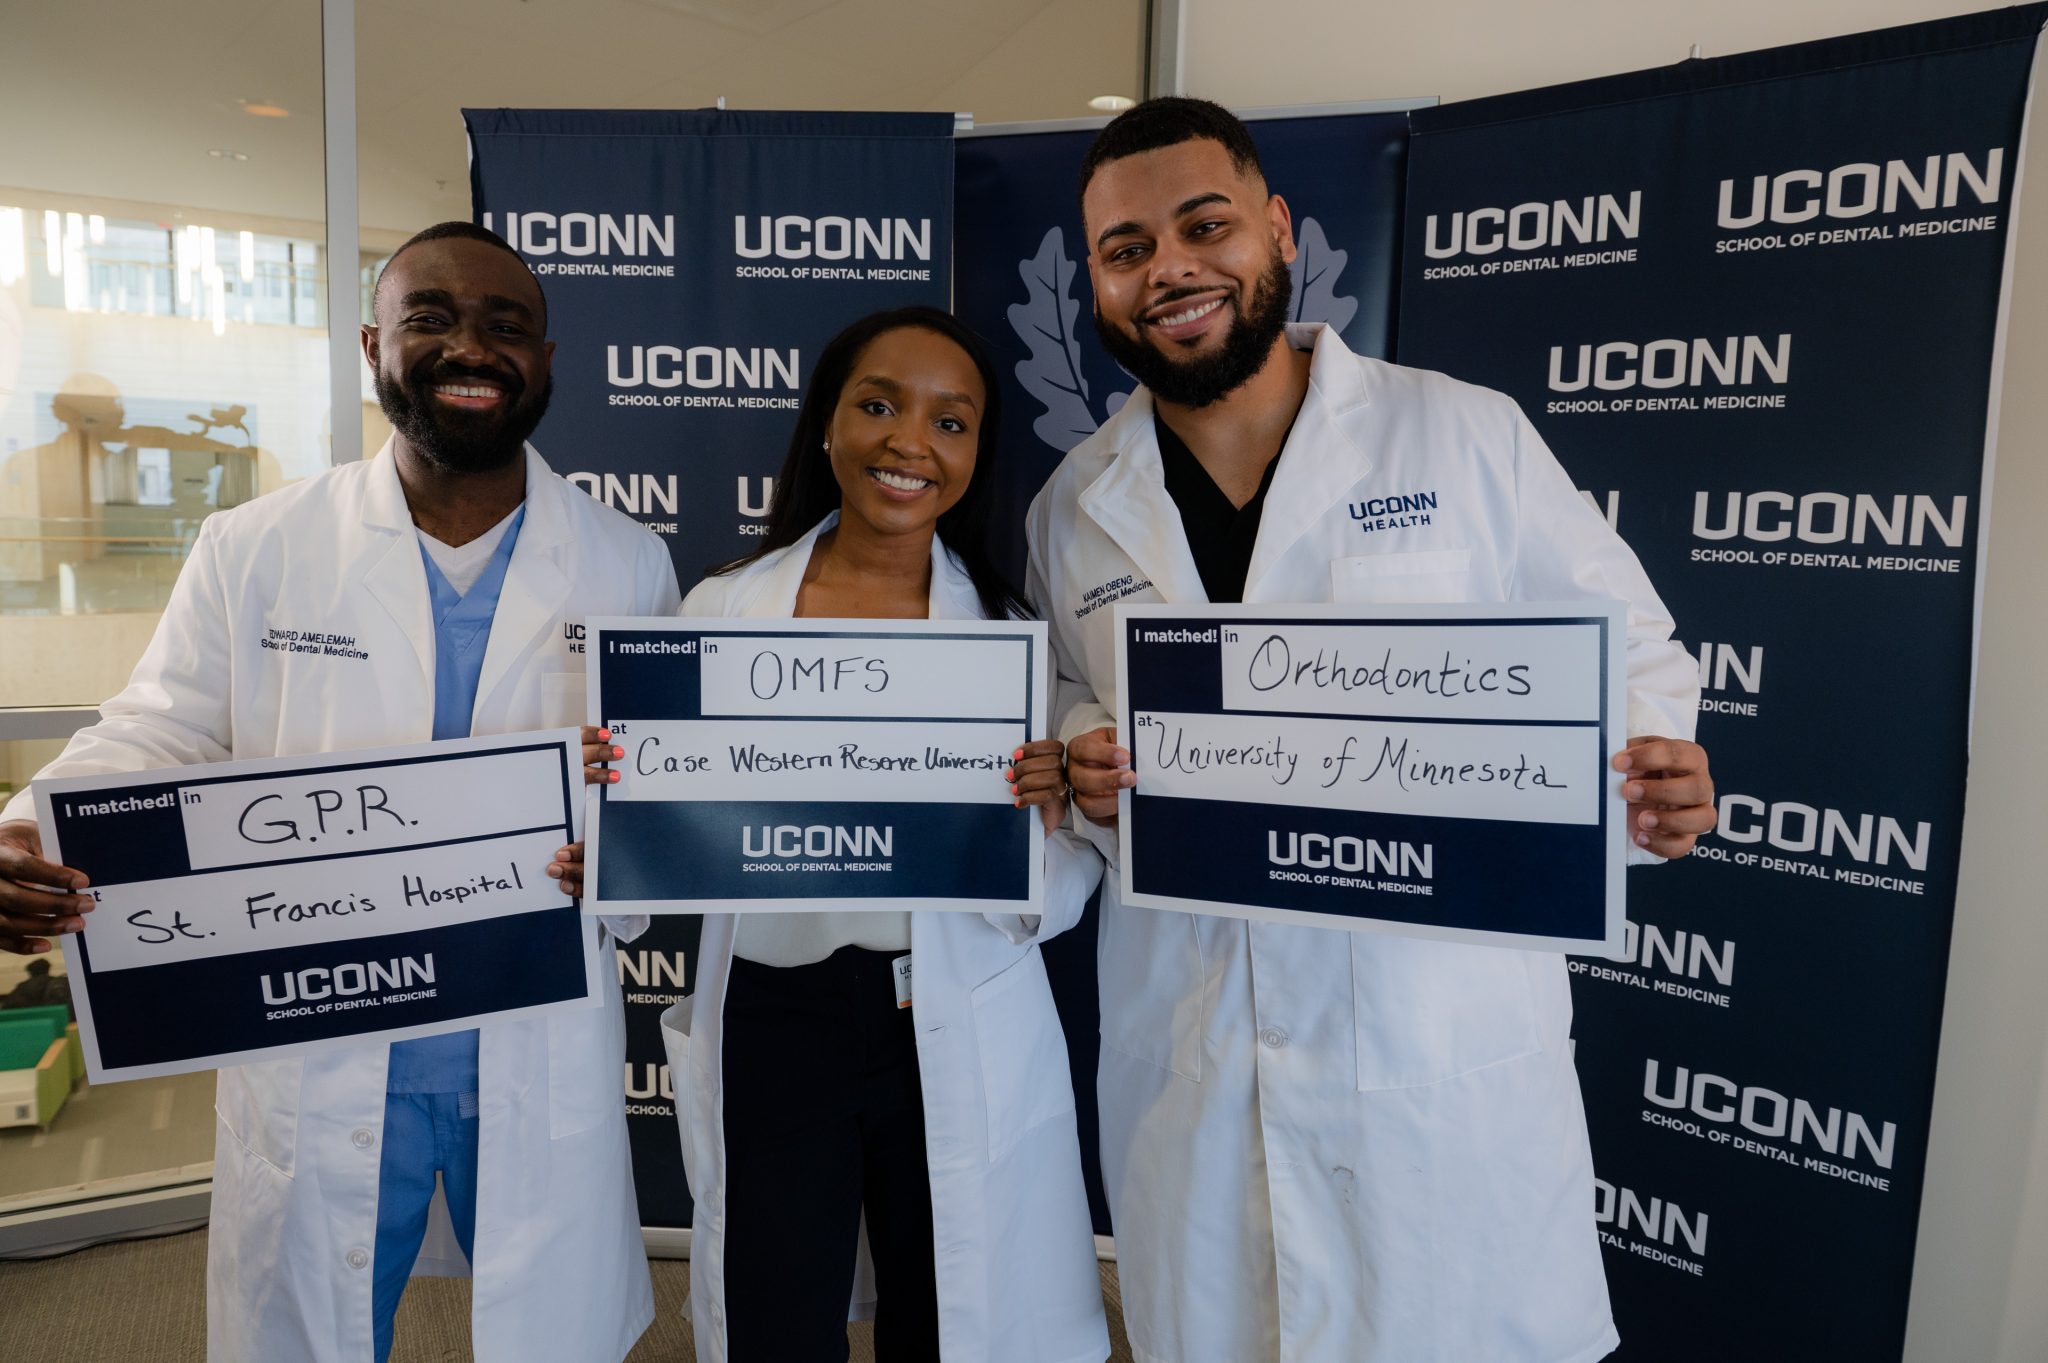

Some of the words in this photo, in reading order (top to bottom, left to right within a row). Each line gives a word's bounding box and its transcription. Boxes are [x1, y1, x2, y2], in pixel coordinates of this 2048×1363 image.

[1717, 148, 2004, 229] UCONN
[483, 212, 674, 257] UCONN
[735, 215, 931, 261] UCONN
[1425, 190, 1642, 259] UCONN
[1715, 236, 1786, 253] SCHOOL
[1790, 232, 1816, 246] OF
[1819, 226, 1893, 244] DENTAL
[1899, 216, 1997, 237] MEDICINE
[537, 264, 556, 275] OF
[558, 264, 609, 275] DENTAL
[612, 265, 674, 277] MEDICINE
[736, 267, 789, 278] SCHOOL
[791, 268, 810, 279] OF
[812, 268, 864, 280] DENTAL
[867, 269, 930, 281] MEDICINE
[1424, 265, 1478, 280] SCHOOL
[1480, 262, 1501, 275] OF
[1503, 258, 1560, 273] DENTAL
[1564, 249, 1638, 268] MEDICINE
[608, 345, 799, 389] UCONN
[1548, 334, 1792, 392] UCONN
[608, 395, 661, 406] SCHOOL
[663, 396, 681, 407] OF
[684, 396, 734, 408] DENTAL
[738, 397, 799, 409] MEDICINE
[1547, 400, 1607, 414] SCHOOL
[1610, 399, 1633, 411] OF
[1635, 398, 1699, 411] DENTAL
[1704, 395, 1786, 409] MEDICINE
[1349, 492, 1437, 520] UCONN
[1363, 514, 1431, 532] HEALTH
[1692, 491, 1968, 547] UCONN
[1690, 549, 1759, 565] SCHOOL
[1762, 551, 1788, 566] OF
[1790, 554, 1862, 568] DENTAL
[1867, 556, 1961, 573] MEDICINE
[1075, 604, 1091, 619] School
[1092, 601, 1097, 611] of
[1098, 591, 1119, 608] Dental
[1121, 580, 1153, 597] Medicine
[1106, 575, 1133, 592] OBENG
[289, 642, 322, 654] Dental
[323, 645, 369, 660] Medicine
[300, 632, 355, 646] AMELEMAH
[609, 641, 614, 653] I
[619, 640, 697, 654] matched!
[704, 641, 718, 653] in
[1135, 629, 1139, 642] I
[1144, 629, 1218, 643] matched!
[1224, 630, 1238, 643] in
[750, 651, 889, 700] OMFS
[1249, 634, 1531, 697] Orthodontics
[611, 723, 627, 735] at
[1138, 715, 1152, 726] at
[636, 737, 712, 776] Case
[729, 744, 832, 773] Western
[838, 744, 921, 772] Reserve
[1155, 721, 1297, 785] University
[1321, 736, 1357, 788] of
[1359, 736, 1567, 792] Minnesota
[65, 803, 72, 818] I
[78, 793, 175, 817] matched!
[183, 791, 202, 806] in
[238, 784, 419, 844] G.P.R.
[742, 825, 893, 858] UCONN
[1717, 794, 1931, 871] CONN
[742, 863, 784, 872] SCHOOL
[786, 863, 800, 871] OF
[802, 863, 841, 871] DENTAL
[844, 863, 892, 871] MEDICINE
[1268, 830, 1433, 879] UCONN
[1269, 871, 1312, 883] SCHOOL
[1314, 875, 1329, 884] OF
[1331, 877, 1375, 889] DENTAL
[1377, 881, 1433, 895] MEDICINE
[1735, 852, 1758, 865] OF
[1761, 856, 1831, 880] DENTAL
[1835, 869, 1925, 895] MEDICINE
[126, 909, 217, 944] St.
[245, 891, 377, 930] Francis
[402, 862, 524, 907] Hospital
[260, 952, 436, 1005] UCONN
[1567, 961, 1588, 974] OF
[1591, 965, 1650, 989] DENTAL
[1654, 979, 1730, 1008] MEDICINE
[266, 1007, 315, 1021] SCHOOL
[316, 1003, 333, 1013] OF
[334, 998, 381, 1011] DENTAL
[382, 989, 438, 1005] MEDICINE
[625, 1105, 673, 1116] SCHOOL
[1643, 1058, 1897, 1170] UCONN
[1641, 1110, 1705, 1139] SCHOOL
[1708, 1129, 1731, 1145] OF
[1733, 1137, 1800, 1166] DENTAL
[1804, 1157, 1890, 1192] MEDICINE
[1595, 1177, 1708, 1256] ONN
[1630, 1241, 1703, 1277] MEDICINE
